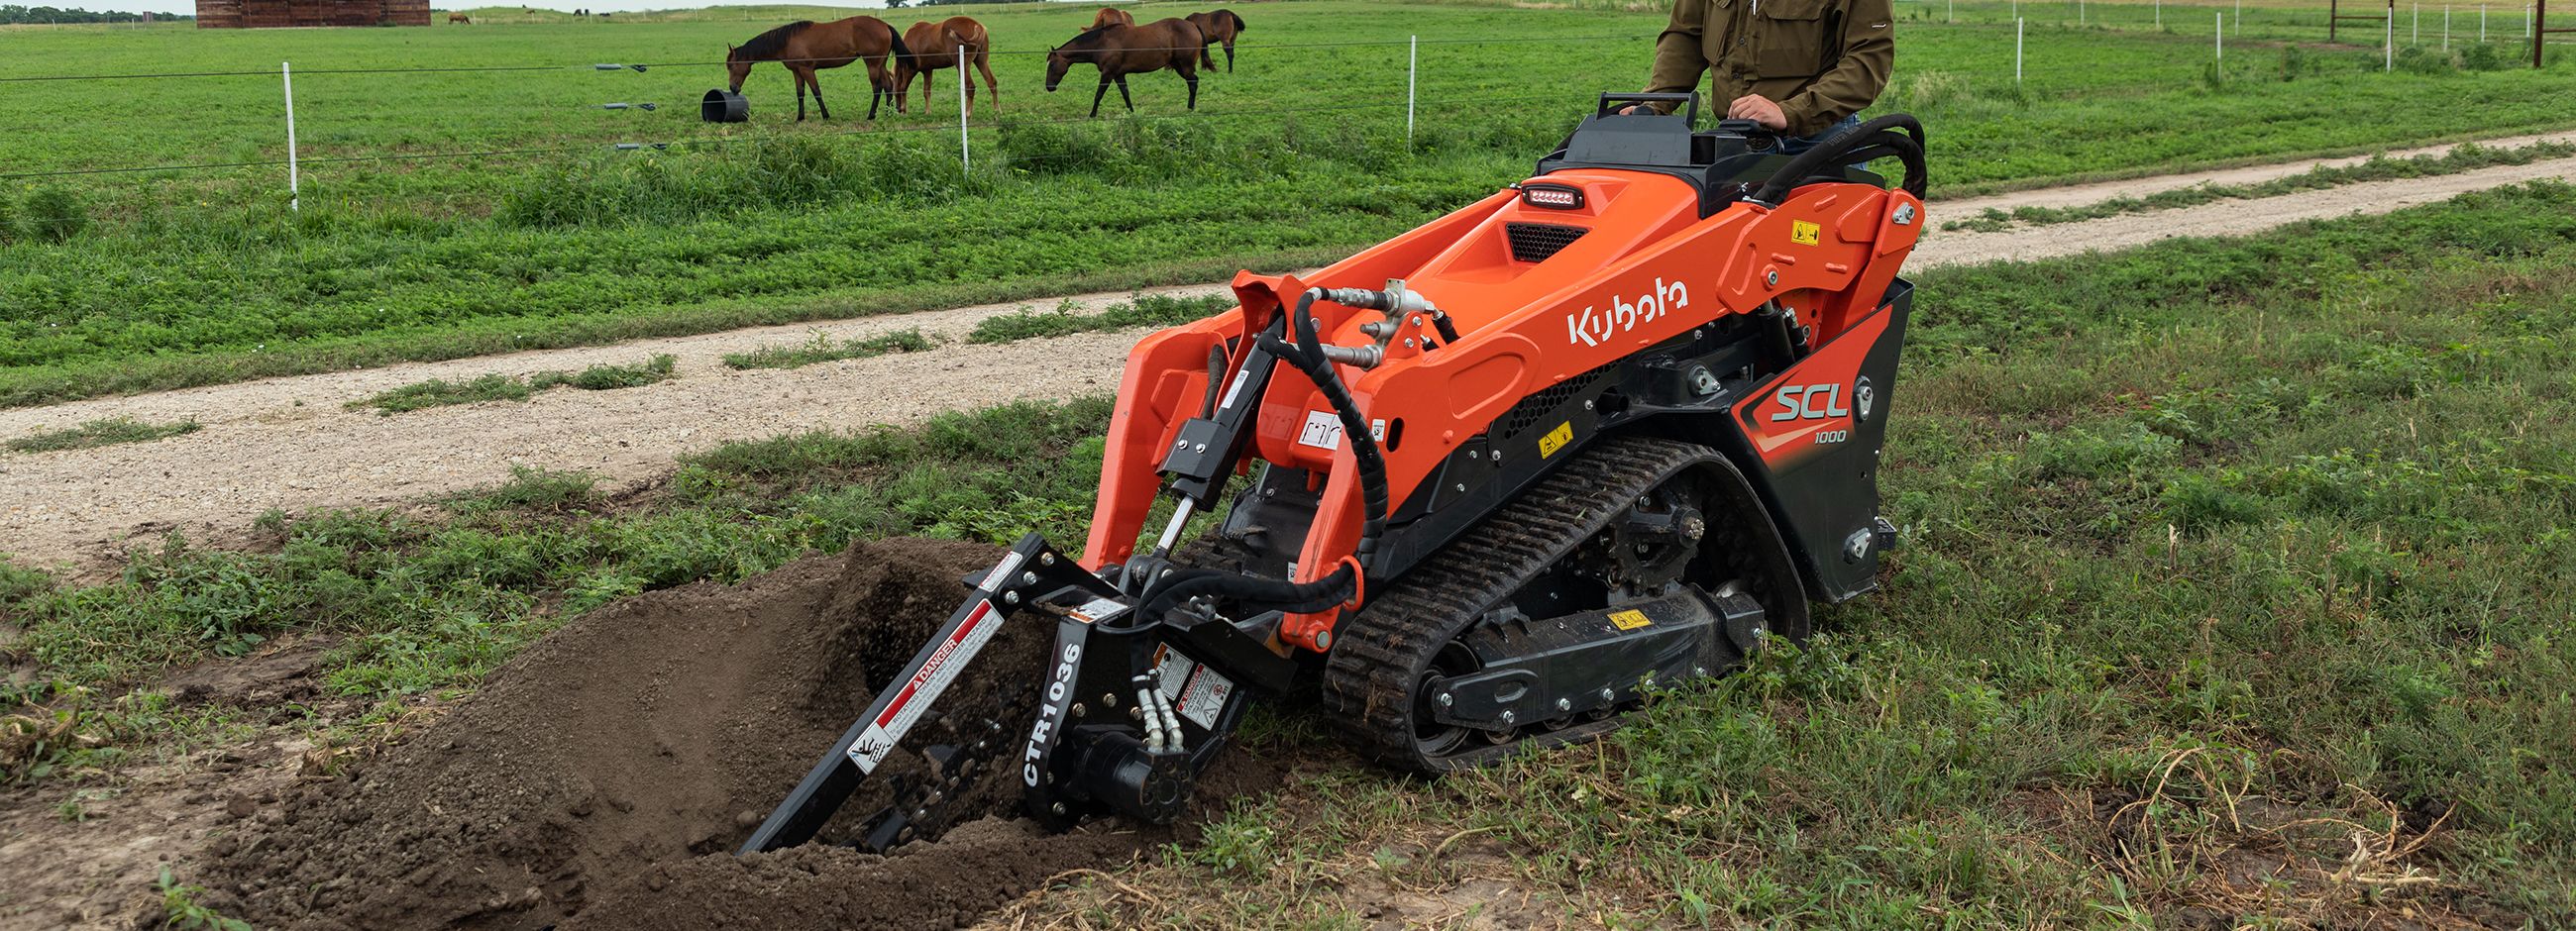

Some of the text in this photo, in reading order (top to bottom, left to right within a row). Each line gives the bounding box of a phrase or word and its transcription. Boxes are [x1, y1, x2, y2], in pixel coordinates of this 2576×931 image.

[1567, 277, 1688, 348] Kubota
[1771, 383, 1848, 421] SCL
[1815, 430, 1847, 445] 1000
[892, 693, 918, 723] ROTATING
[917, 674, 935, 694] CHAIN
[934, 662, 947, 675] AND
[946, 641, 965, 663] AUGER
[964, 617, 987, 642] HAZARD
[918, 638, 957, 680] DANGER
[1183, 671, 1201, 699] DANGER
[1023, 644, 1080, 787] CTR1036
